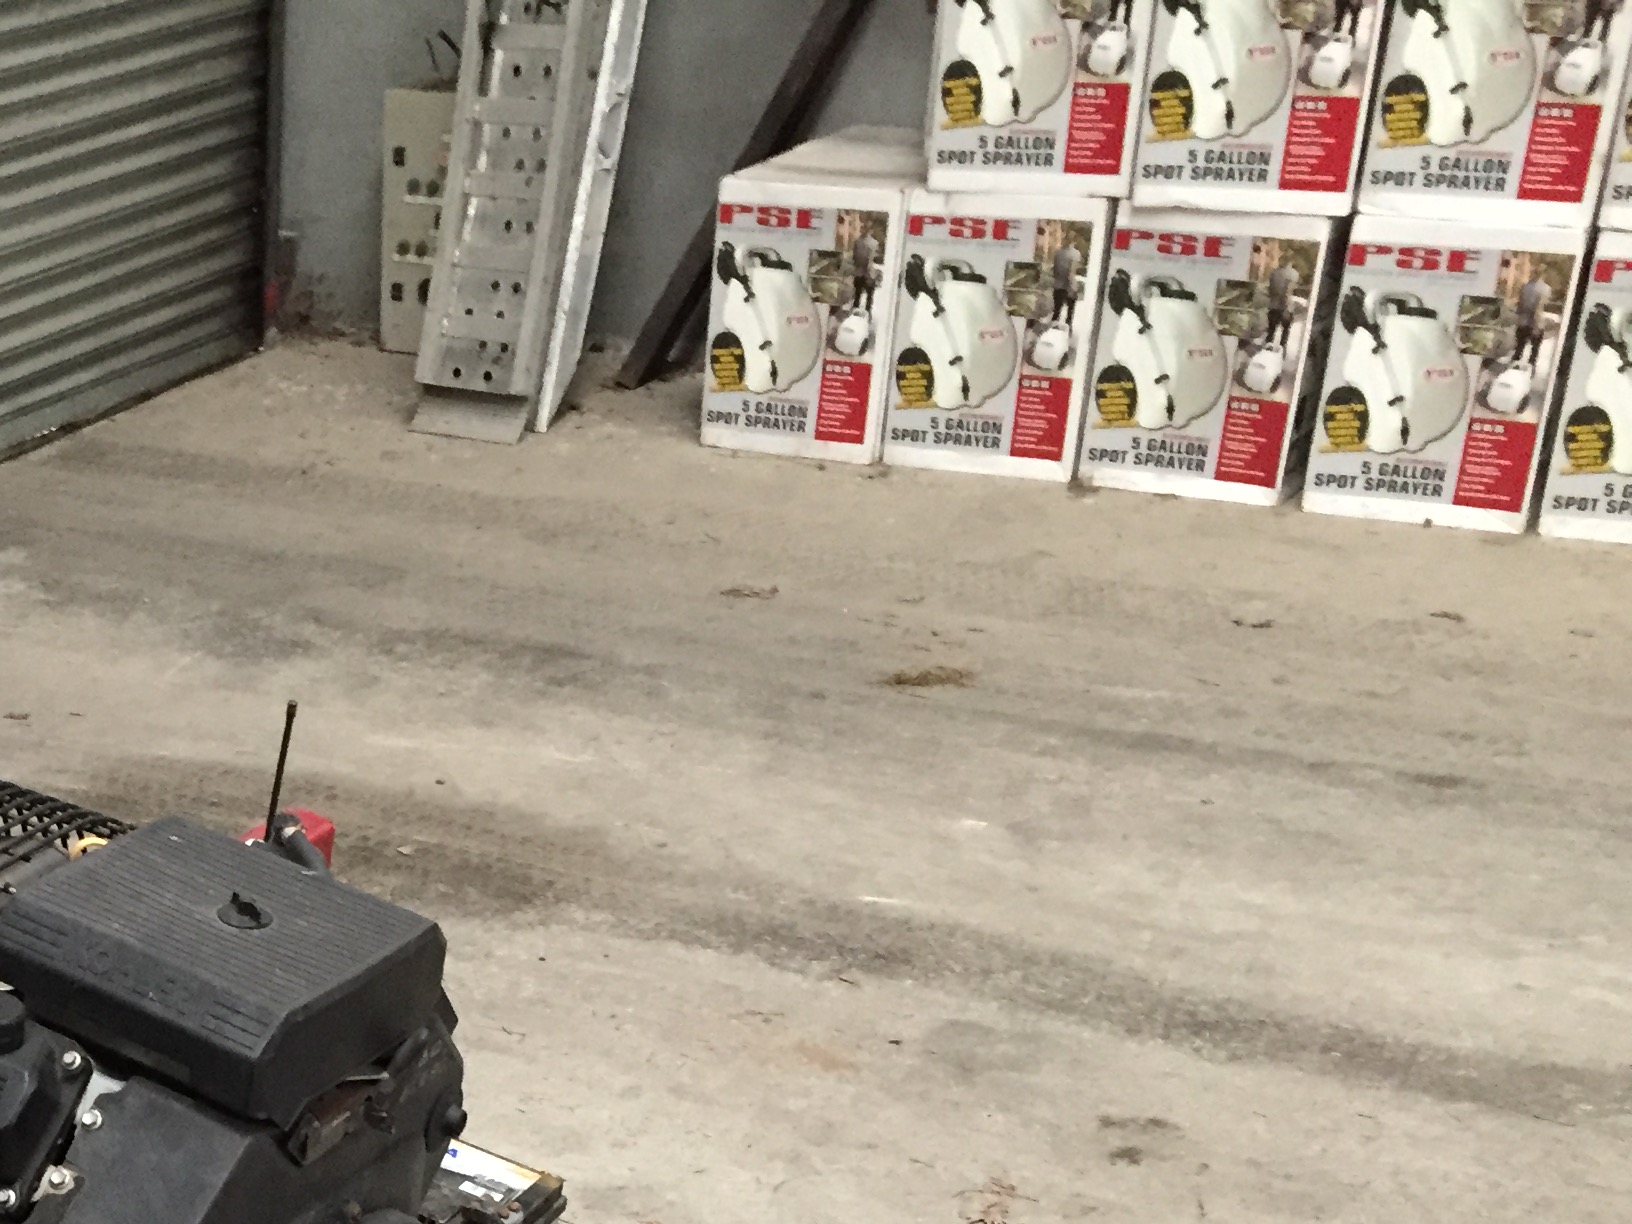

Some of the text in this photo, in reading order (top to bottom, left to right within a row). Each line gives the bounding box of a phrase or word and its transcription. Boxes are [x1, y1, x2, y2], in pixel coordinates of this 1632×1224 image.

[979, 135, 1056, 151] 5 GALLON
[937, 151, 1054, 167] SPOT SPRAYER
[1188, 149, 1271, 166] 5 GALLON
[1420, 155, 1511, 175] 5 GALLON
[1142, 165, 1269, 182] SPOT SPRAYER
[1370, 170, 1506, 191] SPOT SPRAYER
[719, 203, 823, 230] PSE
[908, 214, 1022, 241] PSE
[1113, 228, 1235, 259] PSE
[1347, 243, 1481, 274] PSE
[742, 400, 808, 418] 5 GALLON
[707, 410, 806, 432] SPOT SPRAYER
[930, 416, 1003, 435] 5 GALLON
[891, 428, 1002, 449] SPOT SPRAYER
[1132, 436, 1209, 457] 5 GALLON
[1088, 448, 1206, 472] SPOT SPRAYER
[1361, 461, 1447, 482] 5 GALLON
[1314, 473, 1444, 497] SPOT SPRAYER
[1552, 495, 1598, 511] SPOT
